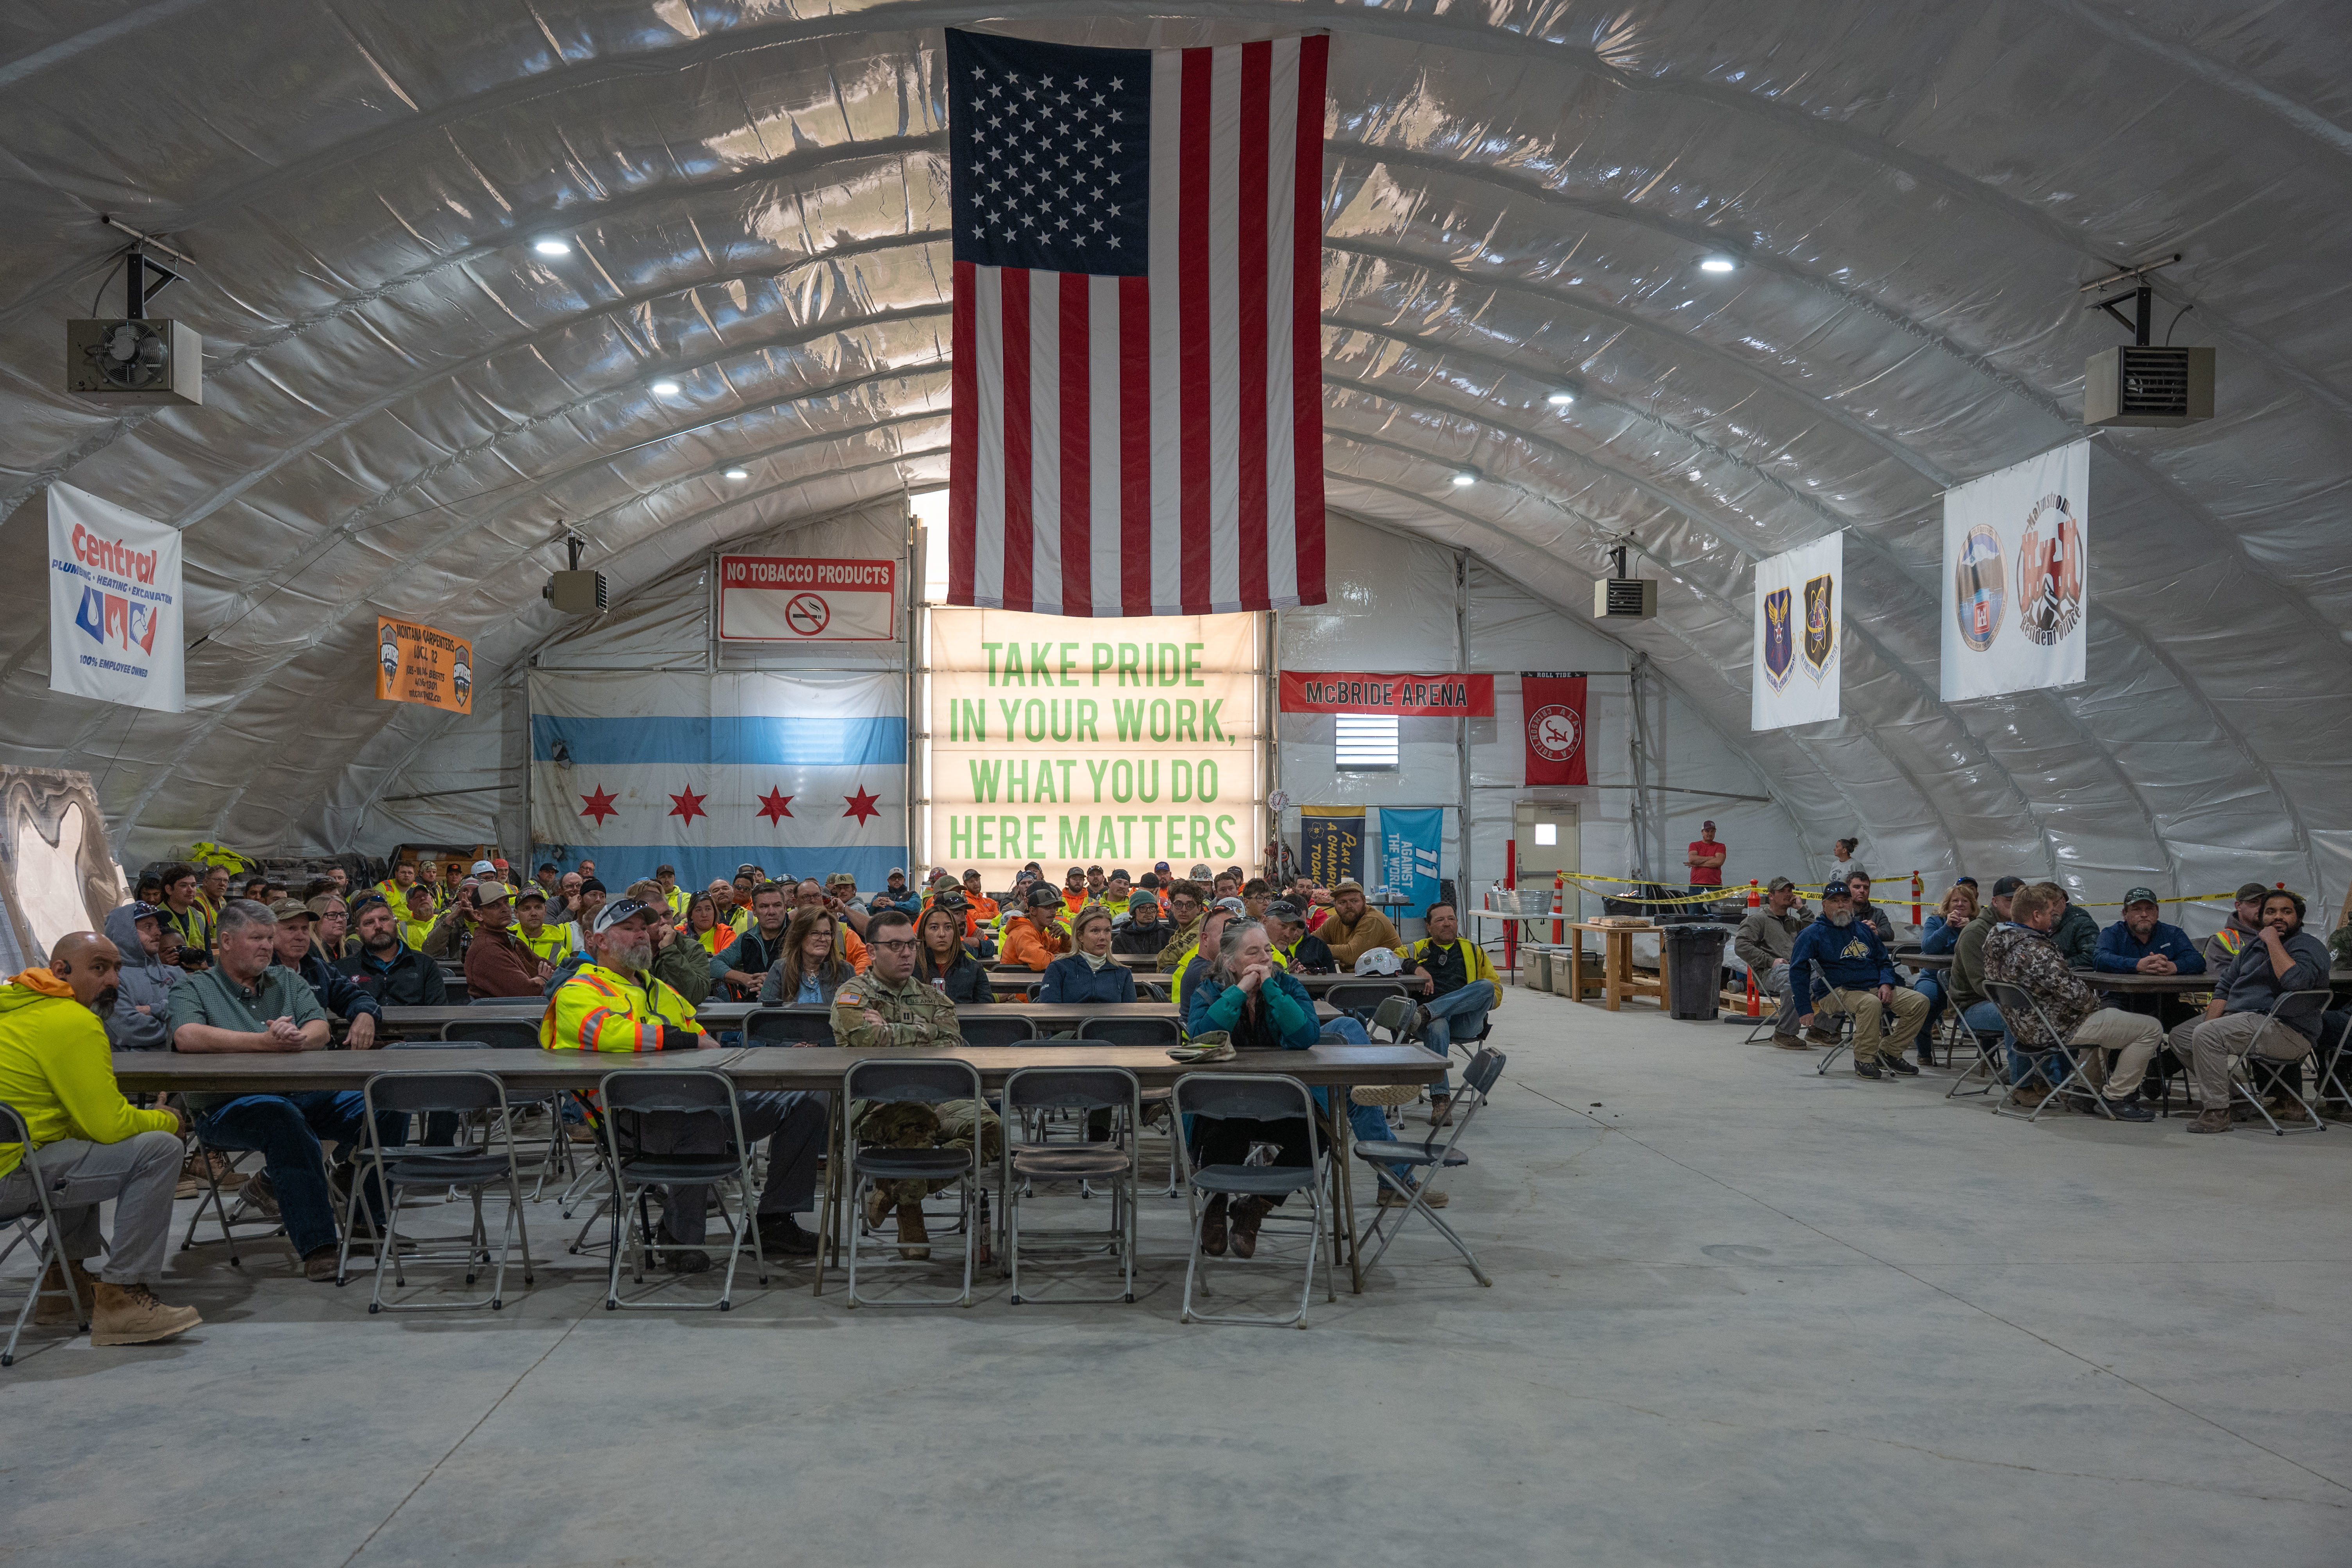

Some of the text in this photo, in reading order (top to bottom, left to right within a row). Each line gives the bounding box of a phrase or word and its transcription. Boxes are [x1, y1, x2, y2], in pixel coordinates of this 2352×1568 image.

[2027, 491, 2070, 531] Malmstrom
[52, 559, 172, 605] PLUMBING HEATING EXCAVATION
[727, 562, 889, 585] NO TOBACCO PRODUCTS
[397, 623, 455, 653] MONTANA CARPENTERS
[2020, 605, 2081, 645] Resident Office
[79, 654, 148, 678] 100% EMPLOYEE OWNED
[431, 650, 437, 664] 82
[981, 642, 1205, 687] TAKE PRIDE
[1305, 681, 1468, 707] McBRIDE ARENA
[950, 698, 1236, 746] IN YOUR WORK,
[1531, 708, 1553, 758] CRIMSON TIDE
[1559, 708, 1579, 757] ALABAMA
[968, 759, 1218, 803] WHAT YOU DO
[950, 815, 1236, 859] HERE MATTERS
[1326, 822, 1338, 891] A CHAMPIO
[1341, 831, 1357, 865] PLAY
[1389, 833, 1400, 853] THE
[1311, 843, 1321, 884] TODAY
[1401, 841, 1413, 888] AGAINST
[1415, 846, 1438, 880] 11
